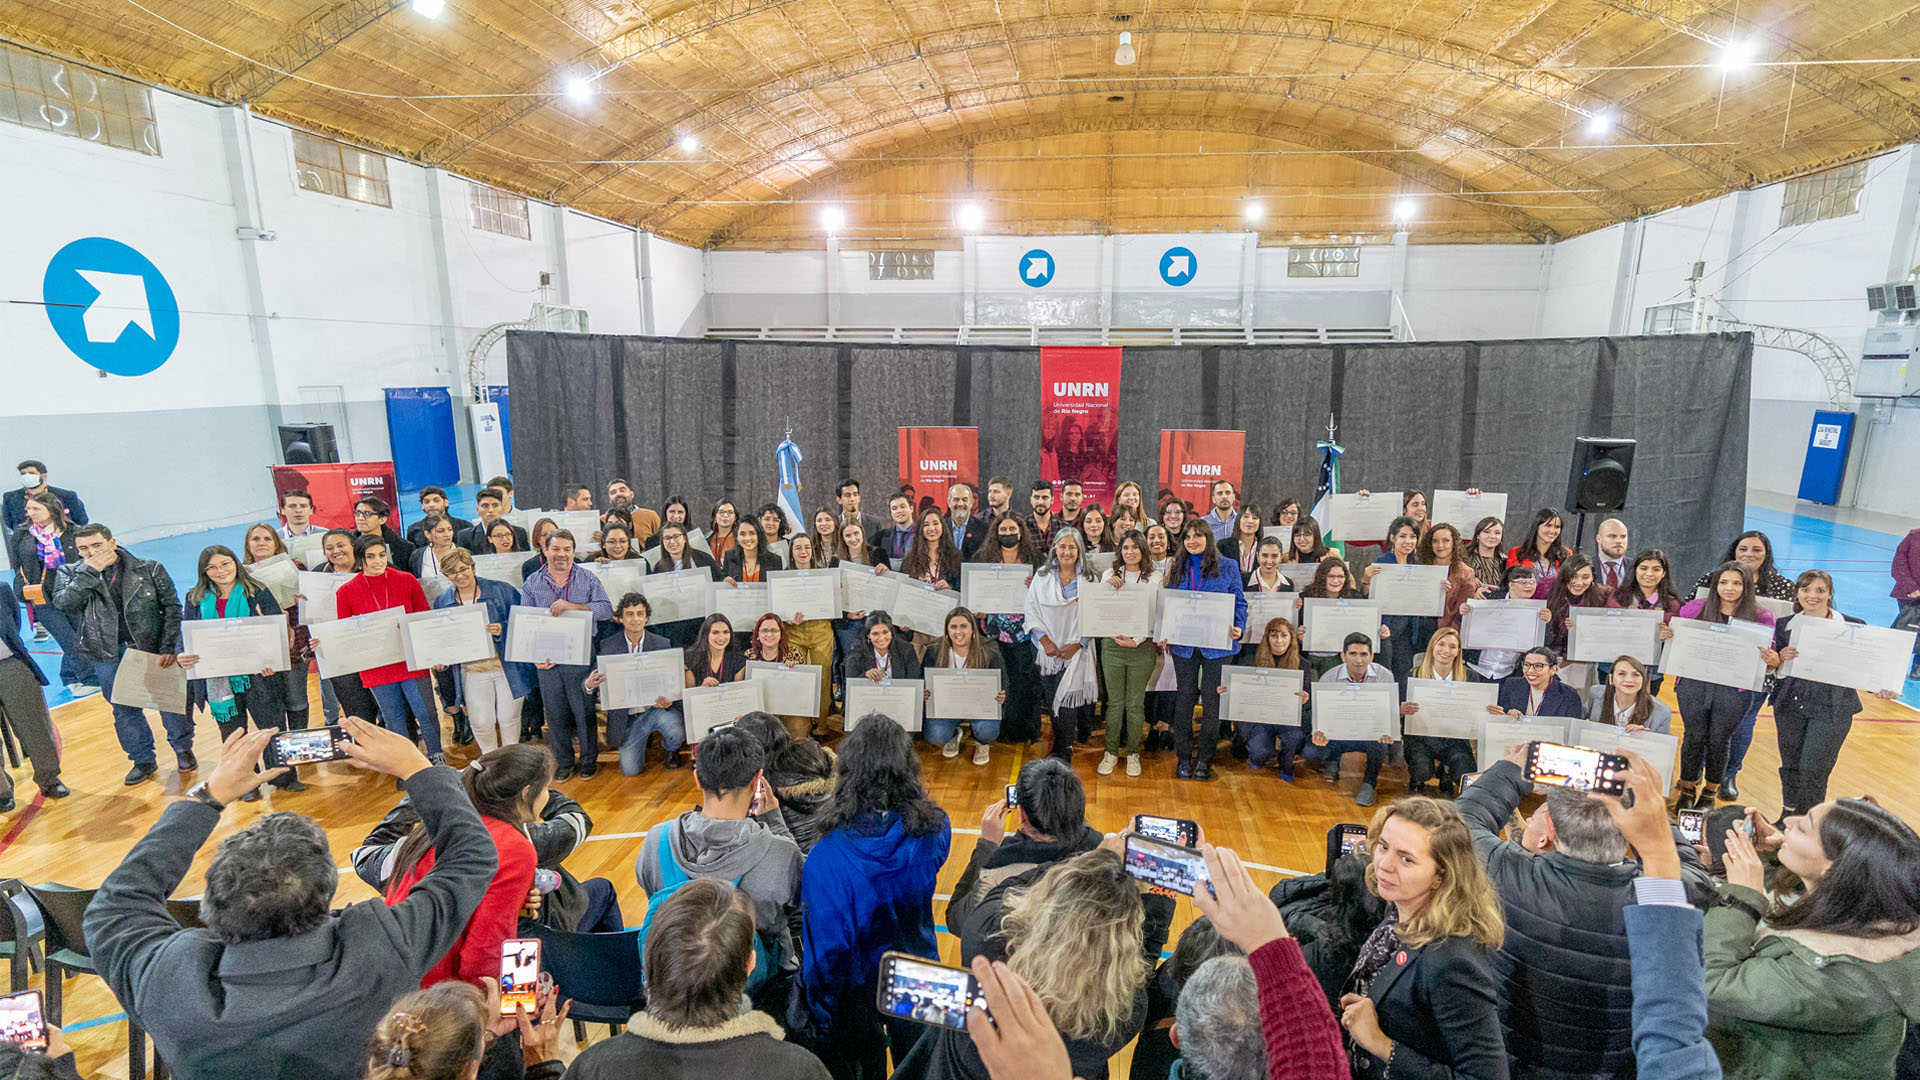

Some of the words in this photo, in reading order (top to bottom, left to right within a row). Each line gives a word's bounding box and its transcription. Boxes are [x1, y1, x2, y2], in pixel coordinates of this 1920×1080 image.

[1053, 382, 1109, 397] UNRN
[920, 460, 958, 471] UNRN
[1181, 464, 1222, 476] UNRN
[350, 476, 384, 486] UNRN
